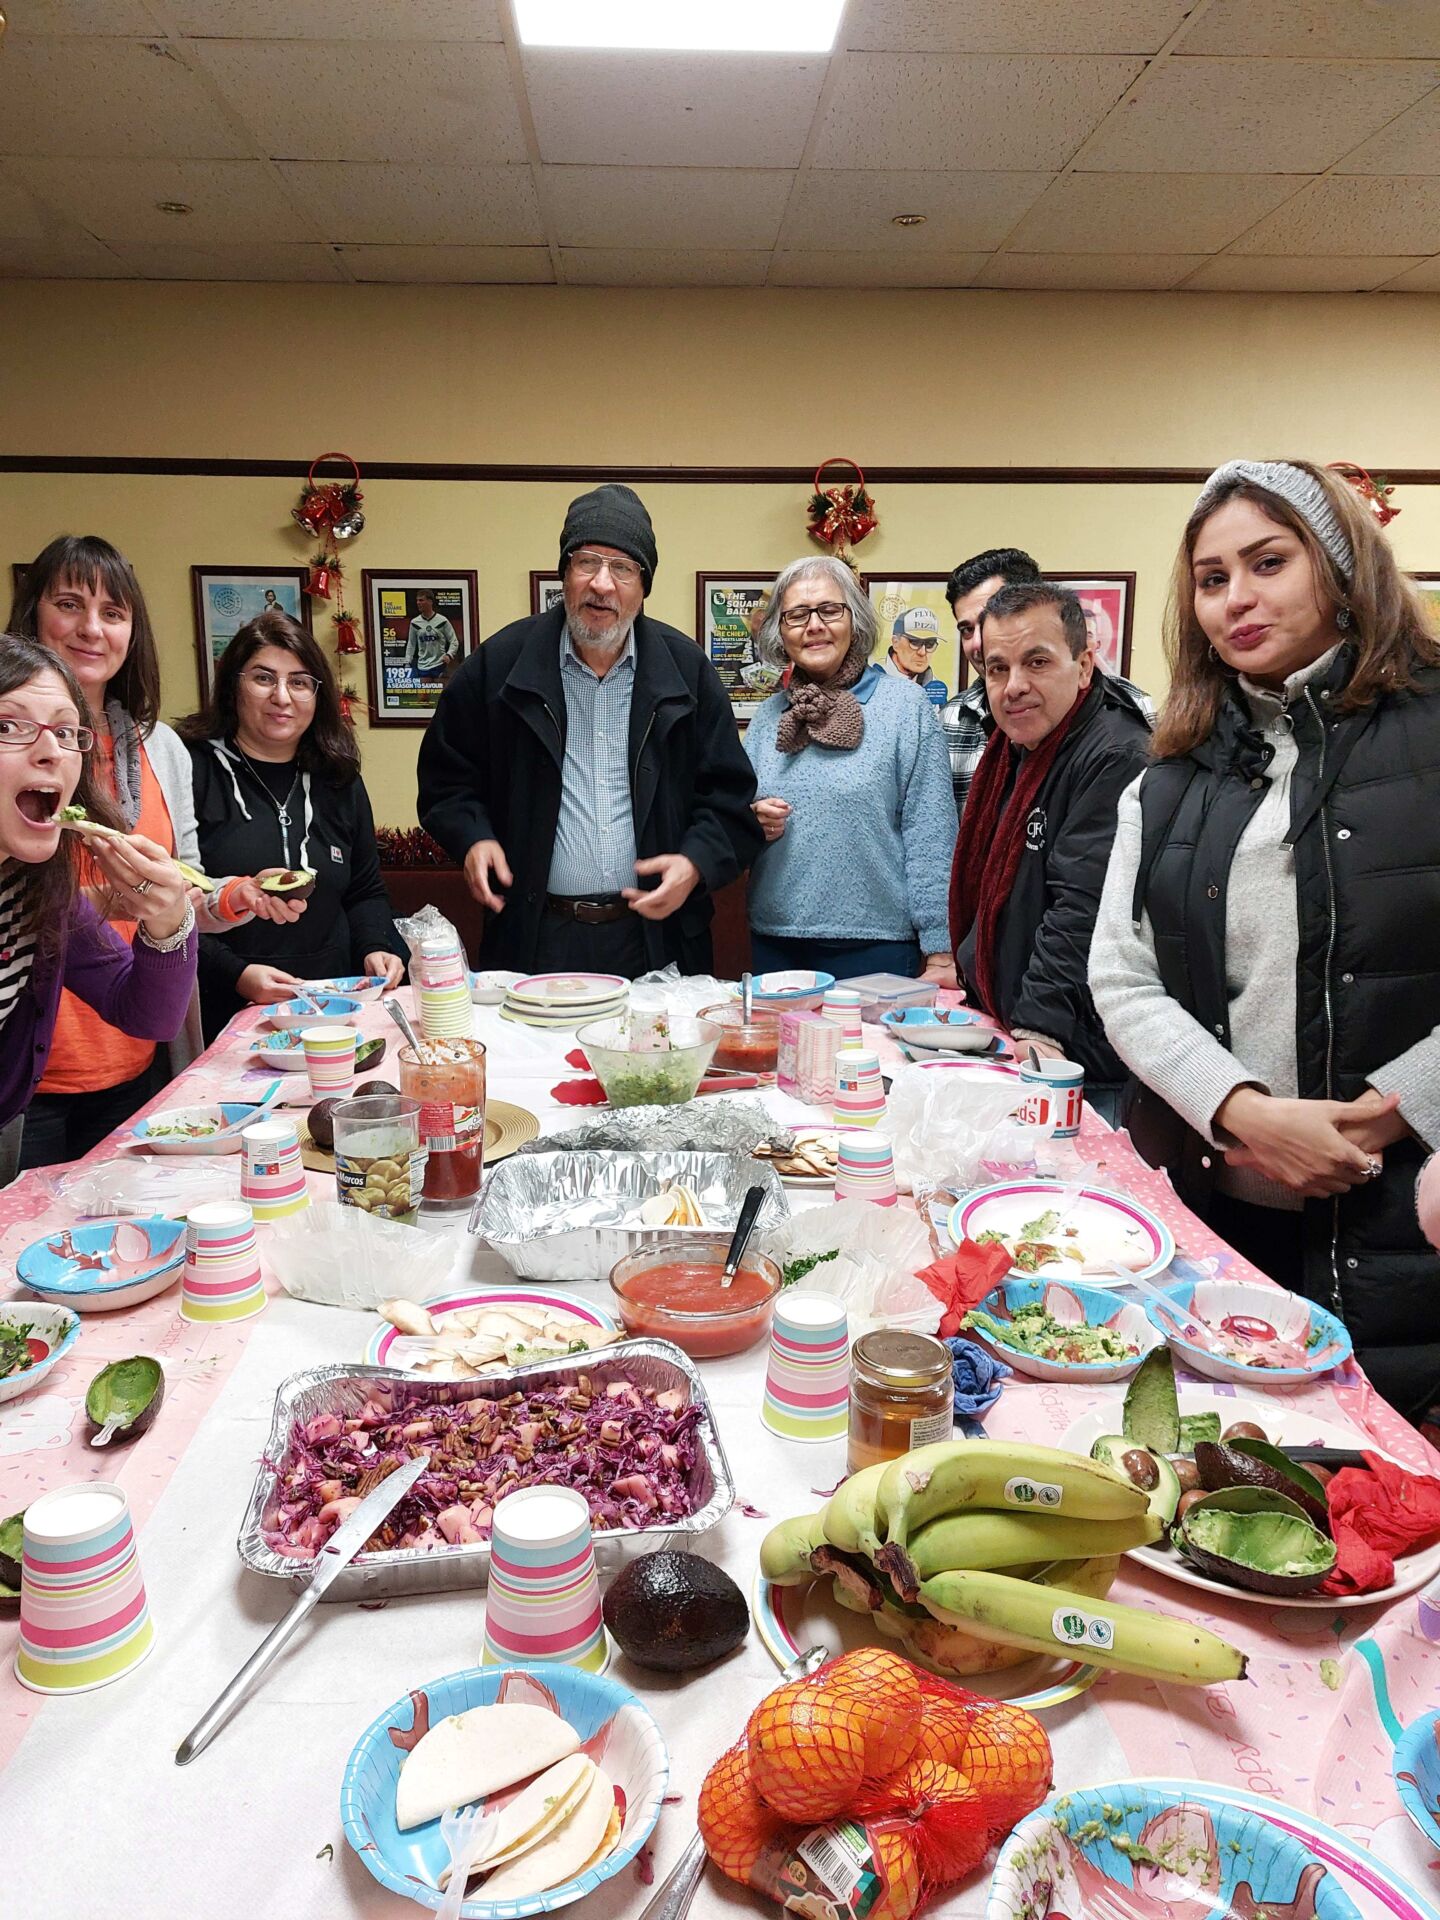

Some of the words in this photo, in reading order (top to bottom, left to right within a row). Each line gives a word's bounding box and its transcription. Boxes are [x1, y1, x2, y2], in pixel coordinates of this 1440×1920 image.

[727, 592, 746, 600] THE
[726, 600, 766, 608] SQUARE
[383, 628, 396, 637] 56
[386, 668, 412, 678] 1987
[340, 1172, 363, 1186] Marcos
[1225, 1732, 1284, 1799] ppy
